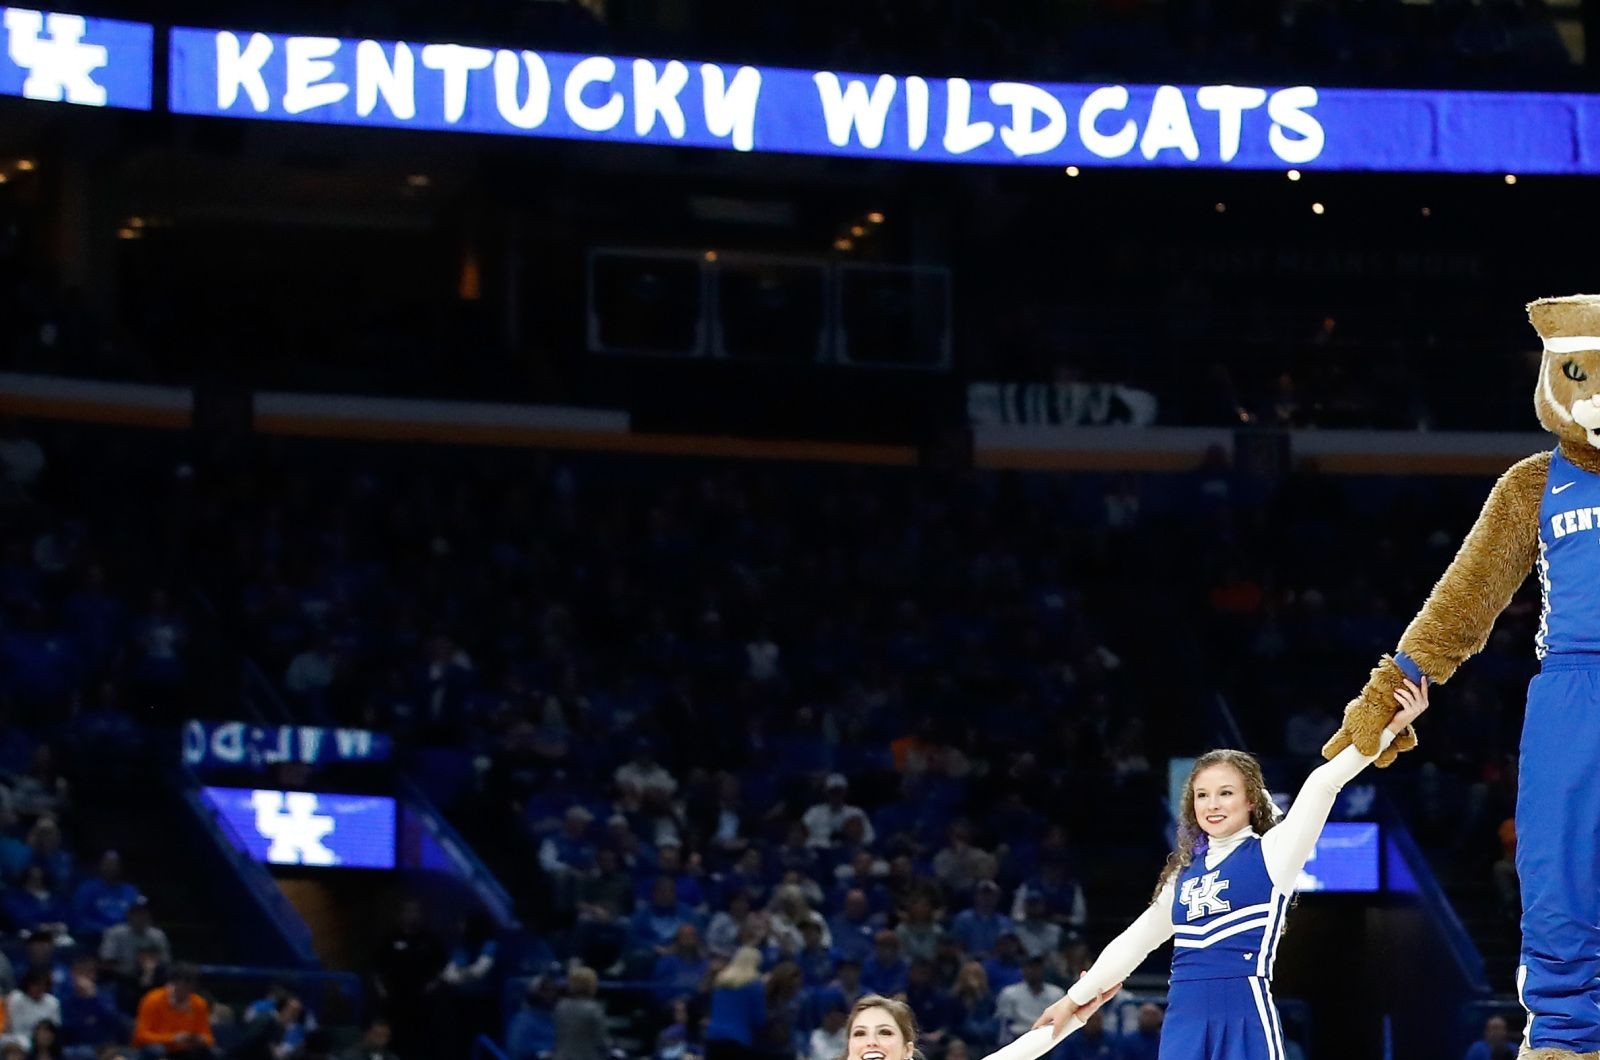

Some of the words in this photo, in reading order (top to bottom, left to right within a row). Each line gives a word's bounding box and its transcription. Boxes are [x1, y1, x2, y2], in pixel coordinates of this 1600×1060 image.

[214, 30, 763, 152] KENTUCKY
[814, 71, 1326, 163] WILDCATS
[252, 789, 337, 867] UK
[1179, 870, 1231, 921] UK
